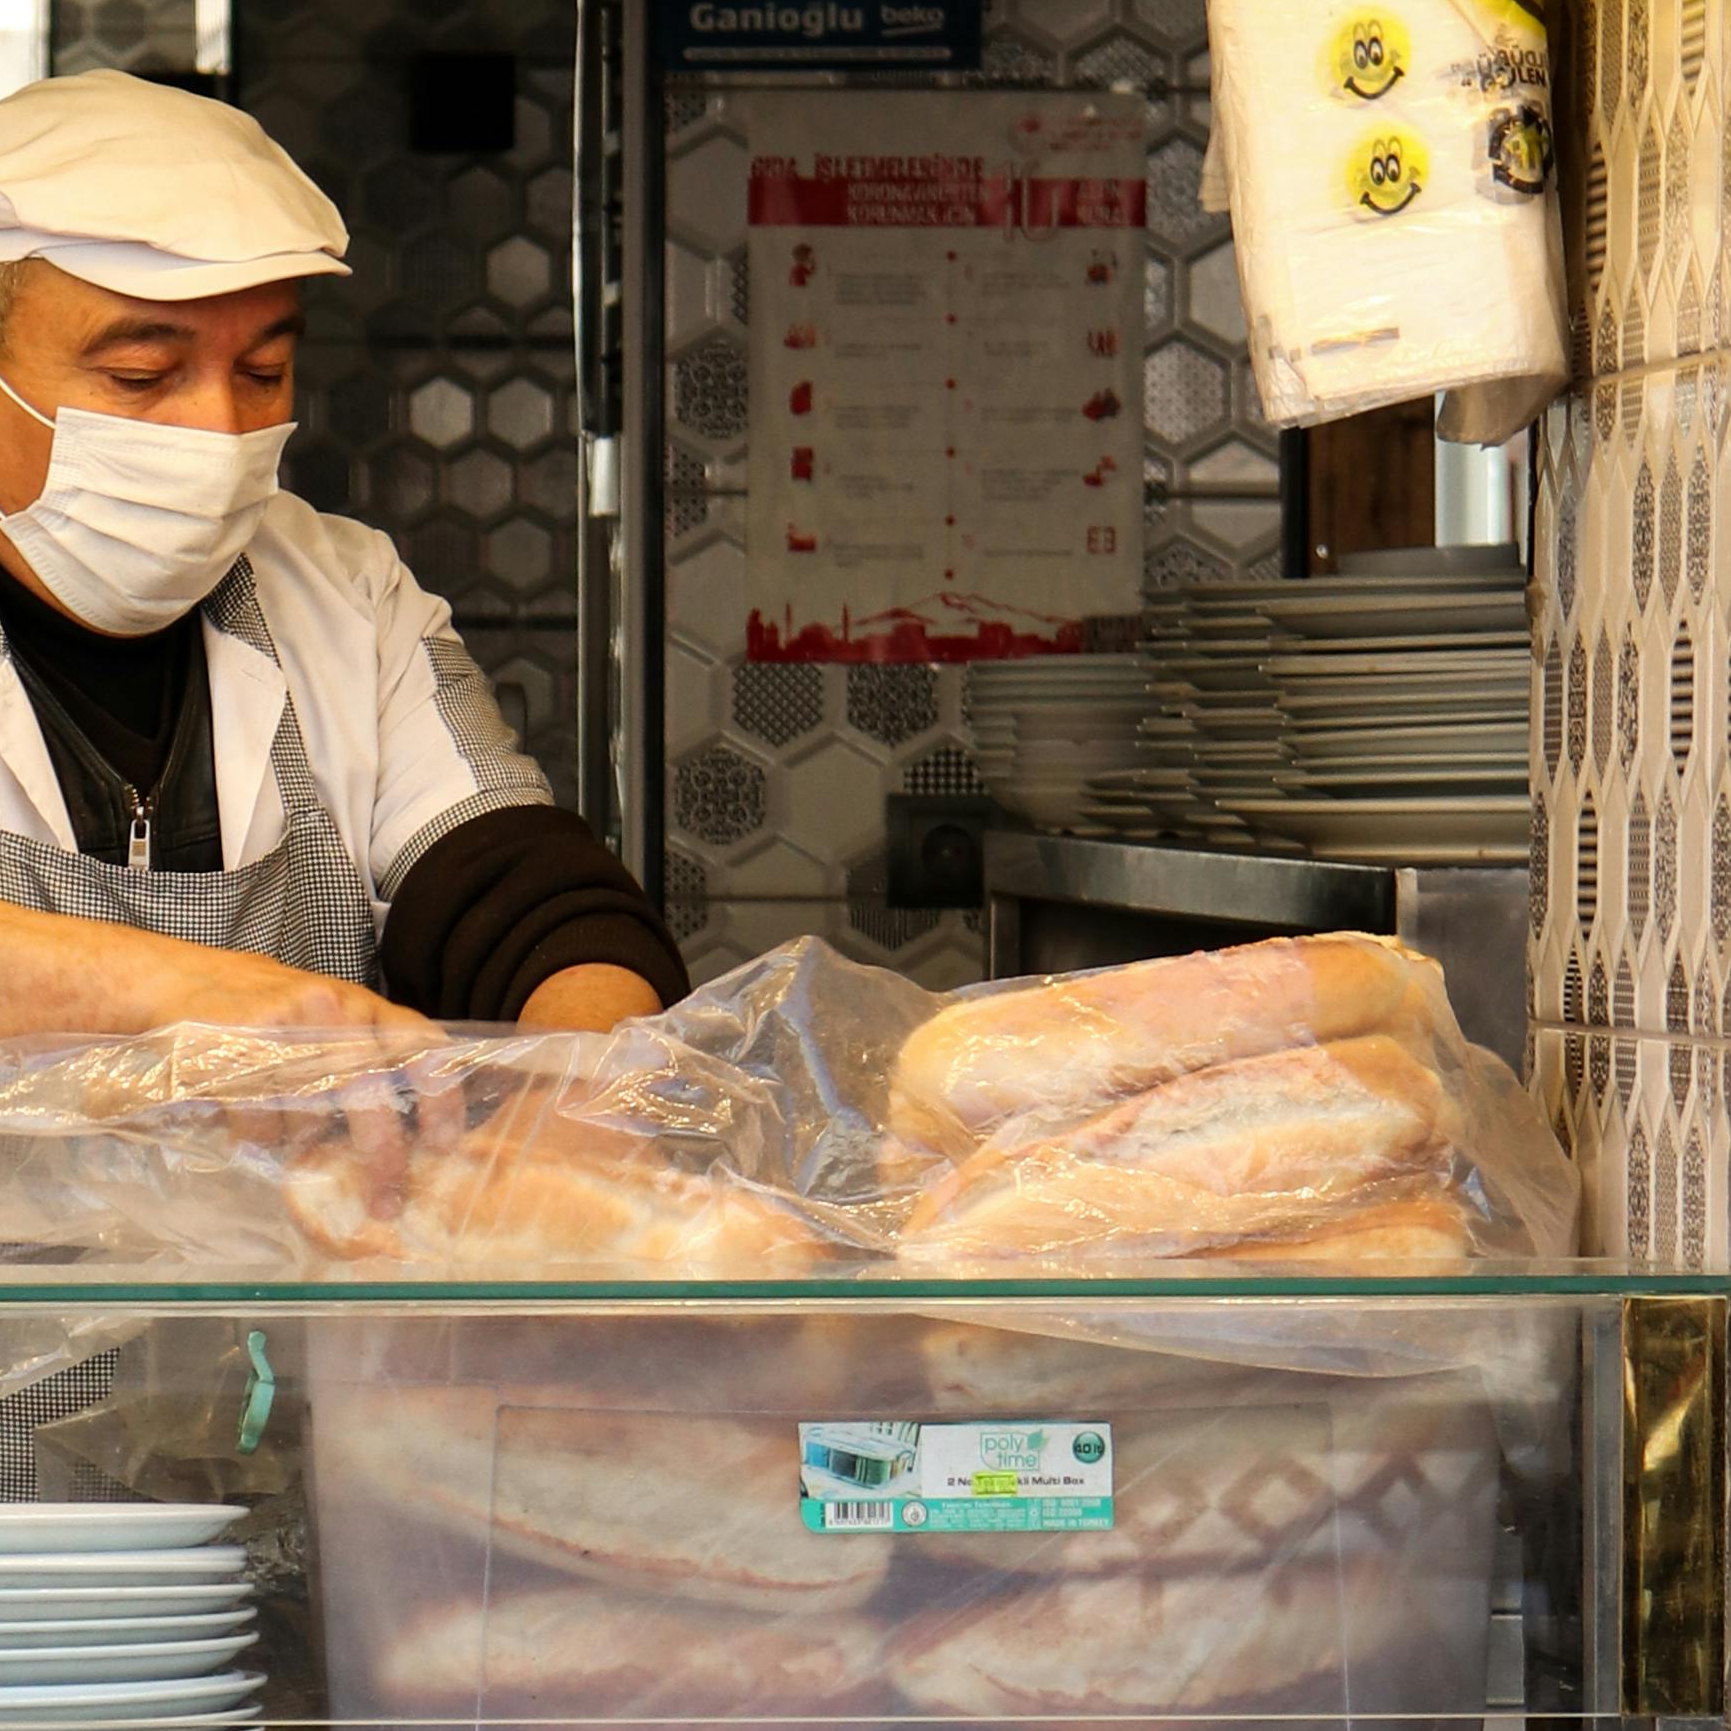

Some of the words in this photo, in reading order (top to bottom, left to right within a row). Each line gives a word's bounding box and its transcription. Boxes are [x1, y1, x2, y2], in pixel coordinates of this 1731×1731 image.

[689, 0, 864, 39] Ganioğlu
[984, 1434, 1024, 1454] poly
[997, 1452, 1038, 1468] time
[947, 1476, 956, 1486] 2
[1031, 1476, 1061, 1486] Multi
[1063, 1476, 1085, 1486] Box
